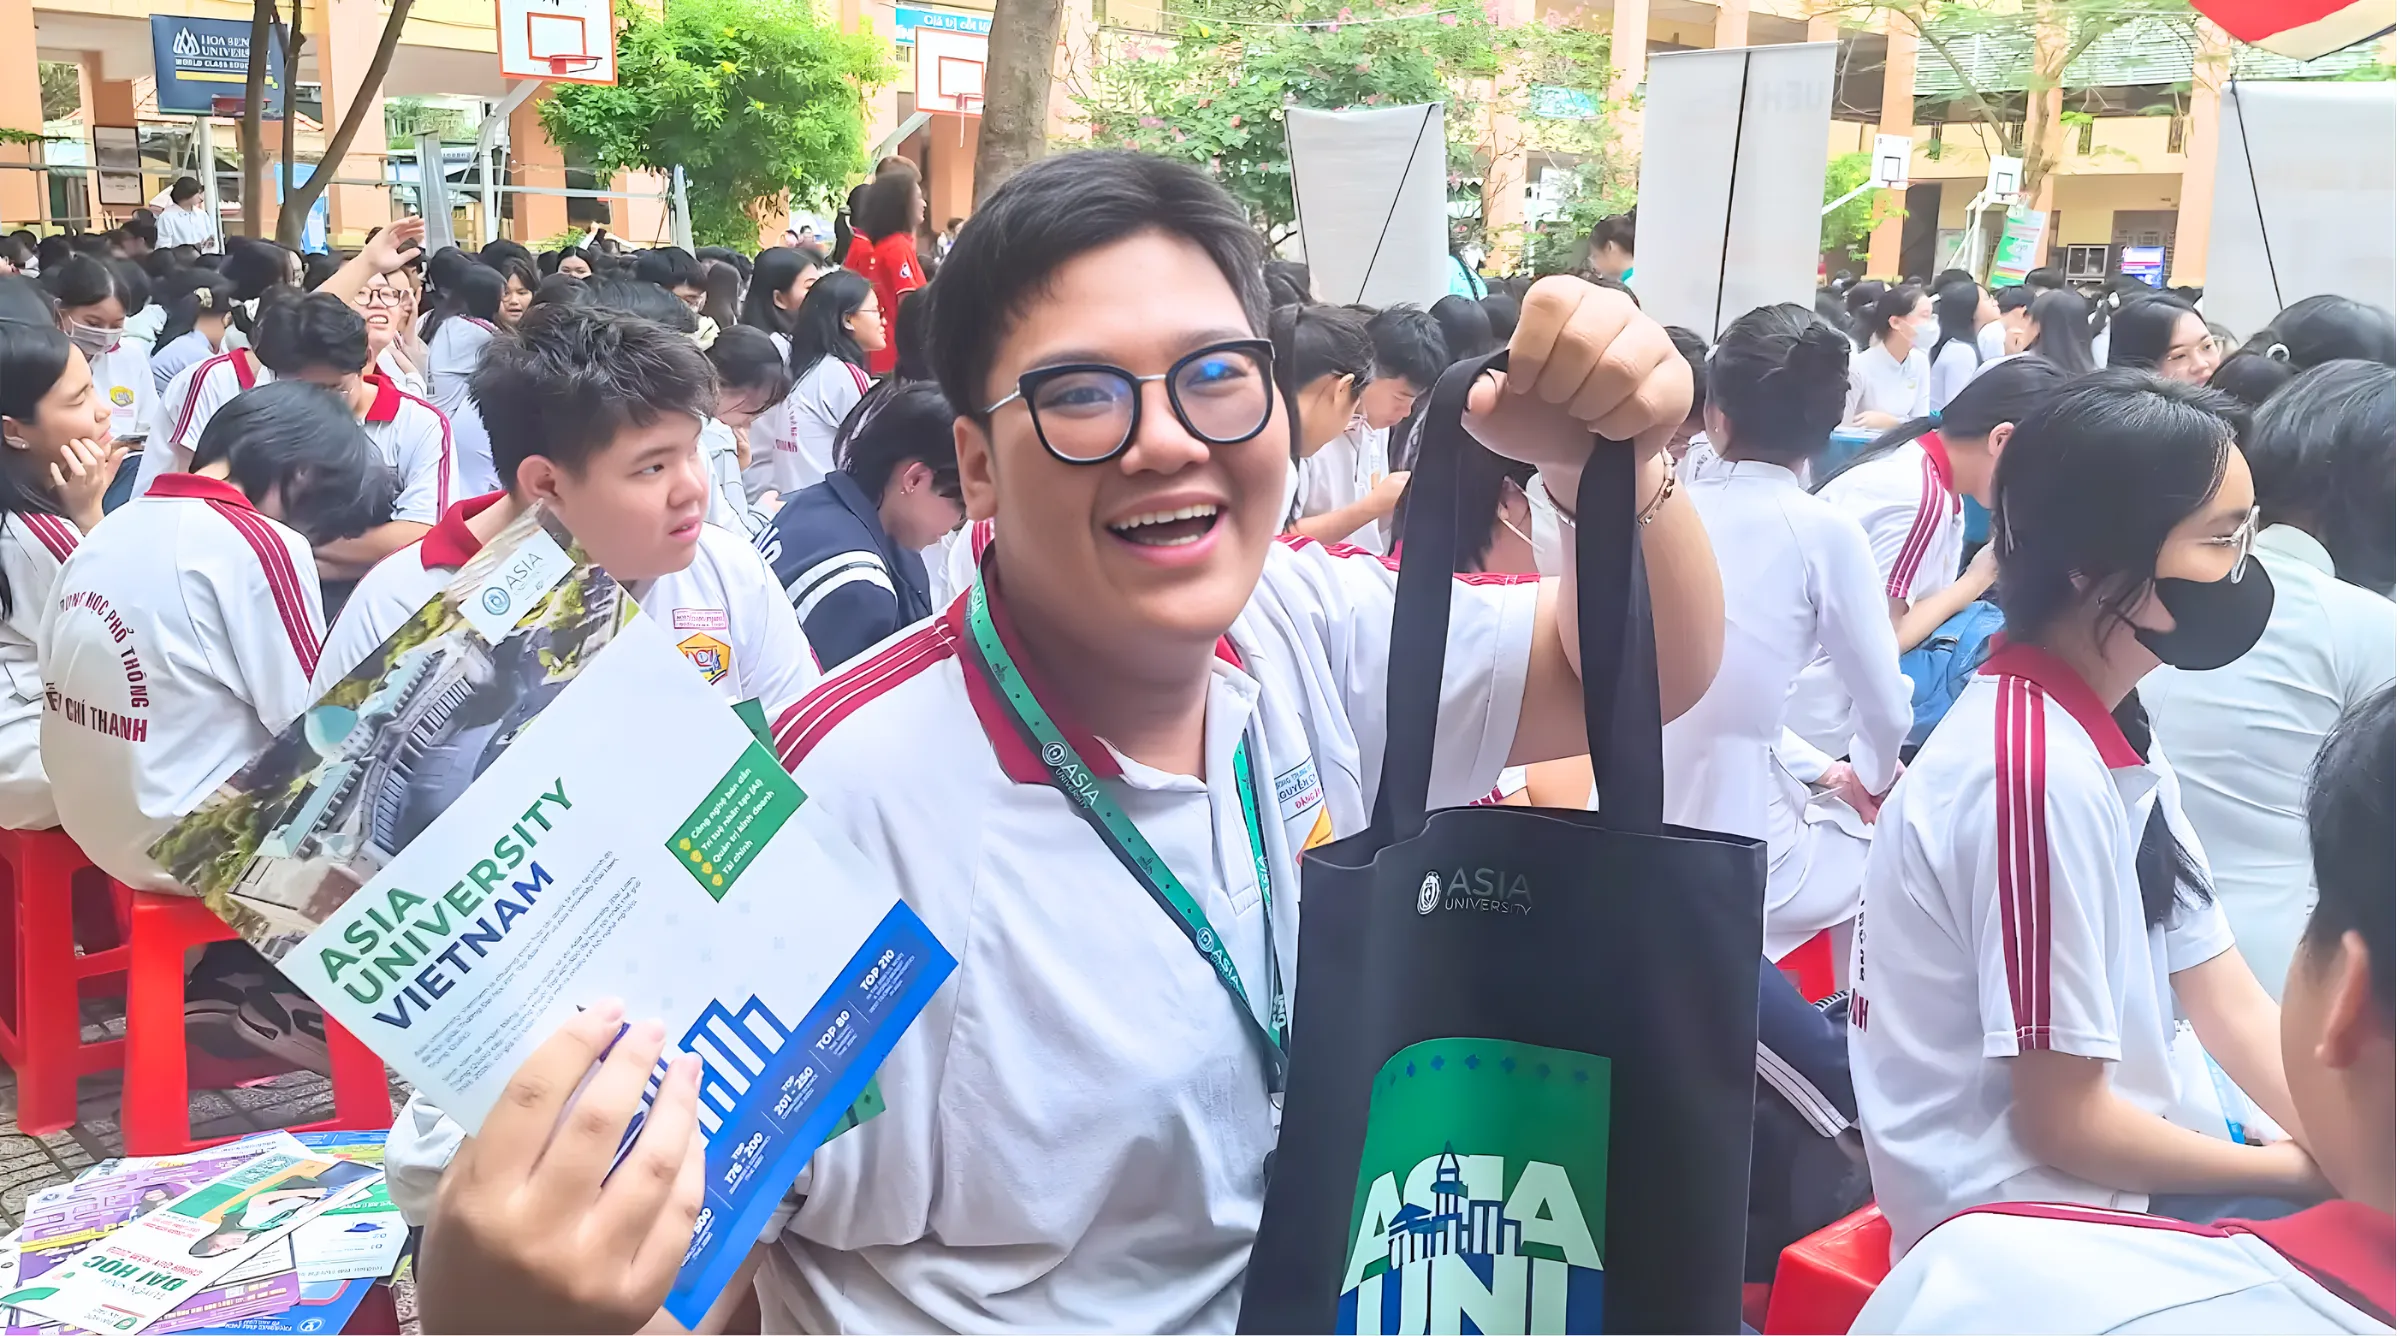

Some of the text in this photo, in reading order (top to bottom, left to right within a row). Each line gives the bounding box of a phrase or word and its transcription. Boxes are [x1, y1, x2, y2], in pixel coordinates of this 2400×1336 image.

[201, 34, 226, 46] HOA
[506, 553, 543, 590] ASIA
[104, 609, 135, 644] PHỔ
[120, 645, 150, 709] THÔNG
[65, 698, 87, 727] CHÍ
[90, 706, 148, 743] THANH
[1055, 769, 1090, 809] UNIVERSITY
[1061, 763, 1100, 806] ASIA
[343, 777, 572, 1004] UNIVERSITY
[1447, 867, 1532, 904] ASIA
[1445, 897, 1532, 916] UNIVERSITY
[319, 888, 428, 983] ASIA
[372, 860, 554, 1030] VIETNAM
[860, 967, 879, 990] TOP
[878, 949, 895, 969] 210
[1212, 949, 1241, 989] ASIA
[815, 1026, 836, 1050] TOP
[836, 1010, 851, 1027] 80
[773, 1094, 792, 1117] 201
[794, 1066, 814, 1090] 250
[781, 1075, 795, 1092] TOP
[724, 1164, 742, 1185] 176
[743, 1132, 763, 1158] 200
[731, 1142, 744, 1160] TOP
[82, 1255, 140, 1280] HỌC
[136, 1271, 188, 1292] ĐẠI
[1356, 1252, 1568, 1335] UNI
